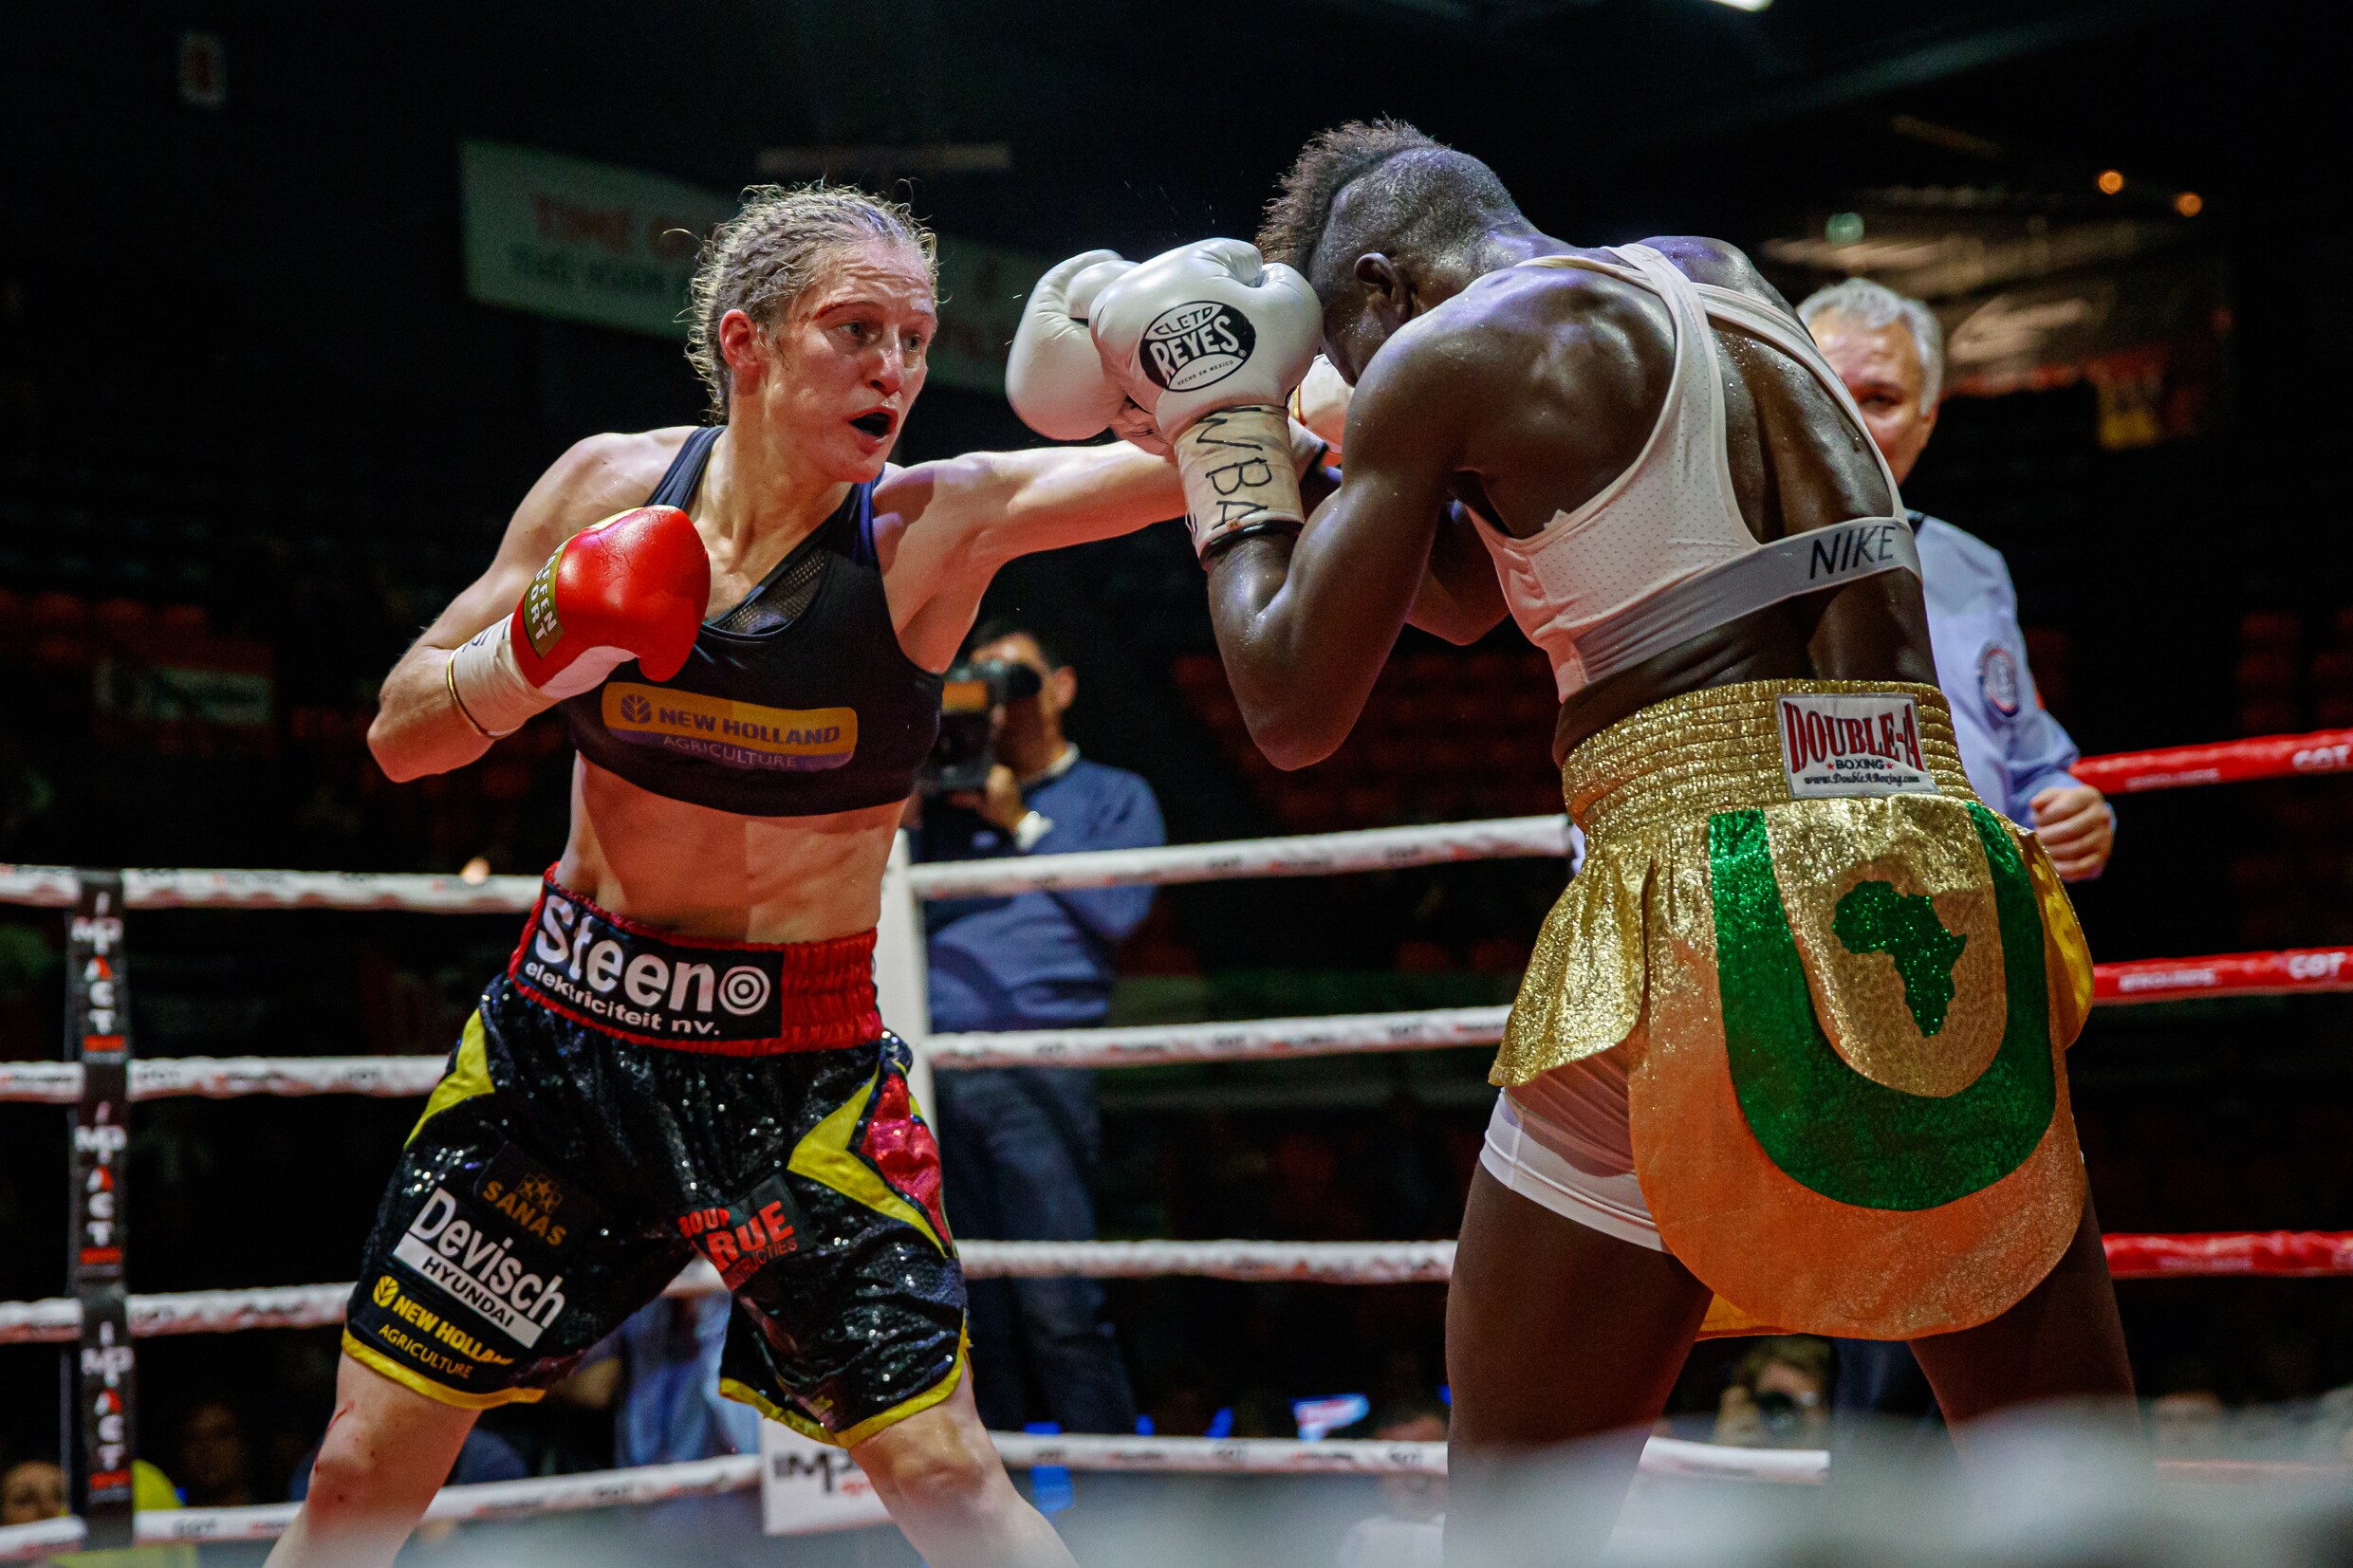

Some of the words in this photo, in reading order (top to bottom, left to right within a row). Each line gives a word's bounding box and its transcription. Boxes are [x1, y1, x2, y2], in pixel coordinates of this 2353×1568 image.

[1153, 305, 1214, 336] CLETO
[1149, 315, 1239, 388] REYES
[1809, 525, 1897, 580] NIKE
[658, 707, 716, 733] NEW
[722, 720, 841, 746] HOLLAND
[663, 734, 799, 768] AGRICULTURE
[1783, 701, 1925, 774] DOUBLE-A
[1835, 758, 1885, 770] BOXING
[525, 960, 662, 1031] elektriciteit
[671, 1018, 721, 1037] nv.
[482, 1180, 567, 1246] SANAS
[408, 1187, 566, 1329] Devisch
[392, 1294, 439, 1333] NEW
[421, 1256, 517, 1328] HYUNDAI
[378, 1322, 474, 1379] AGRICULTURE
